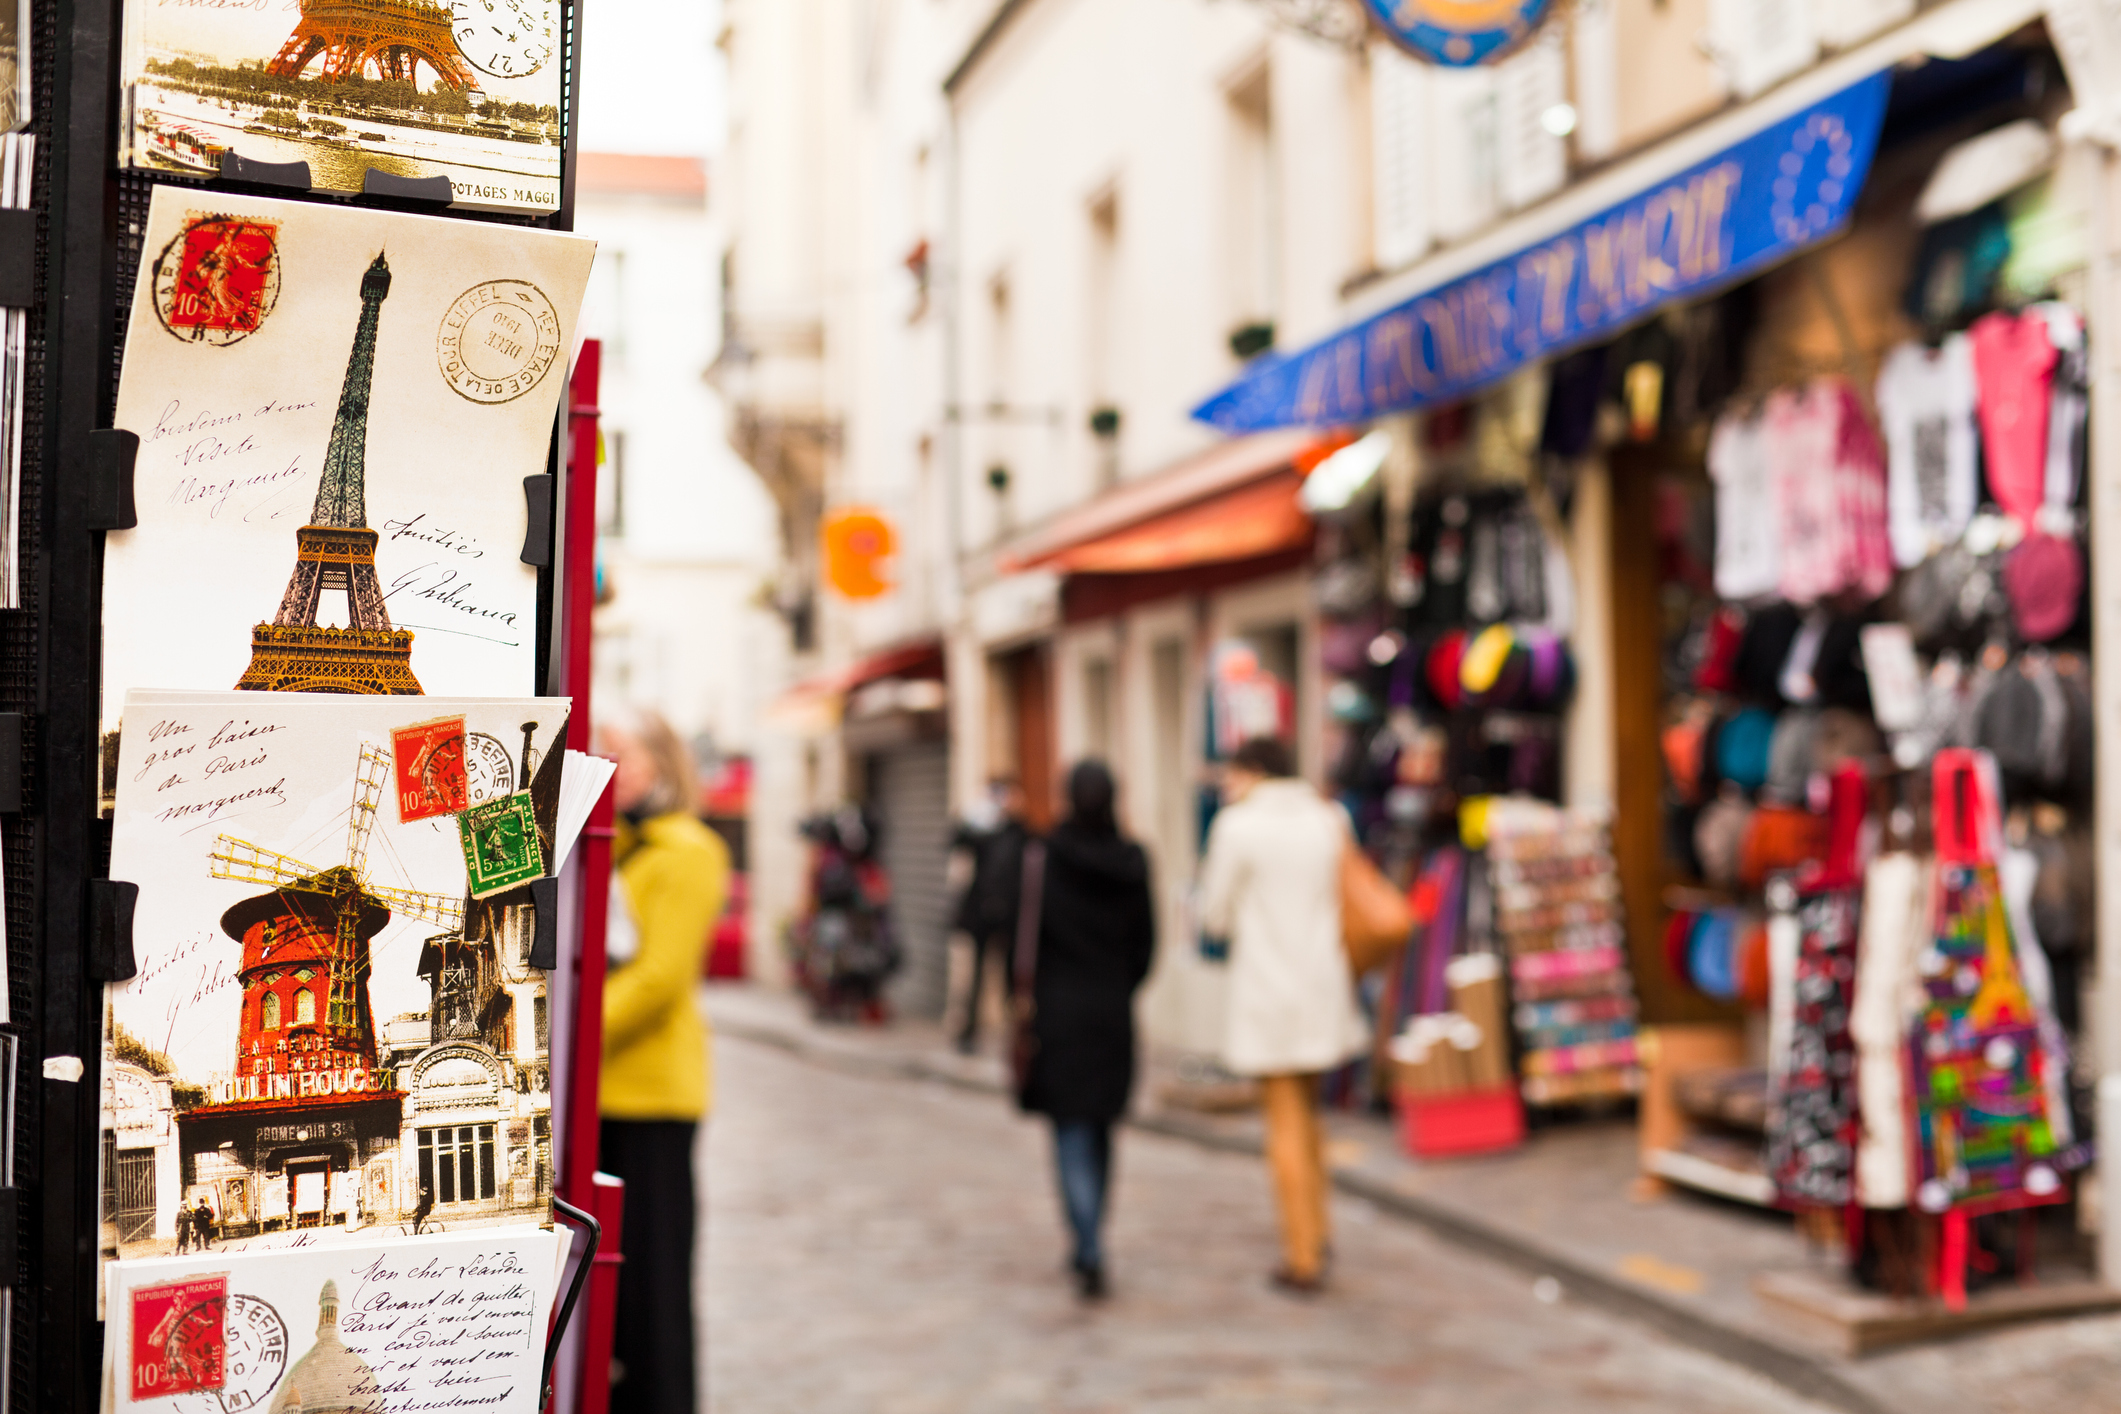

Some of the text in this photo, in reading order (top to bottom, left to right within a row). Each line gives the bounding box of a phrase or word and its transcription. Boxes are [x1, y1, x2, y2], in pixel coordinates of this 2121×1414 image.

[450, 182, 555, 205] POTAGES MAGGI
[447, 285, 500, 329] EIFFEL
[493, 312, 522, 334] 1910
[442, 336, 464, 384] TOUR
[509, 344, 556, 393] ETAGE
[148, 720, 195, 743] Un
[134, 720, 287, 783] gros baiser
[157, 747, 268, 792] de Paris
[463, 834, 476, 871] DIEU
[407, 1257, 454, 1280] cher
[441, 1289, 465, 1307] de
[468, 1283, 531, 1312] quitter
[341, 1312, 401, 1333] Paris
[437, 1309, 486, 1324] vous
[384, 1330, 467, 1352] cordial
[211, 1344, 221, 1381] POSTES
[352, 1355, 395, 1374] nir
[397, 1356, 423, 1372] et
[428, 1349, 486, 1368] vous
